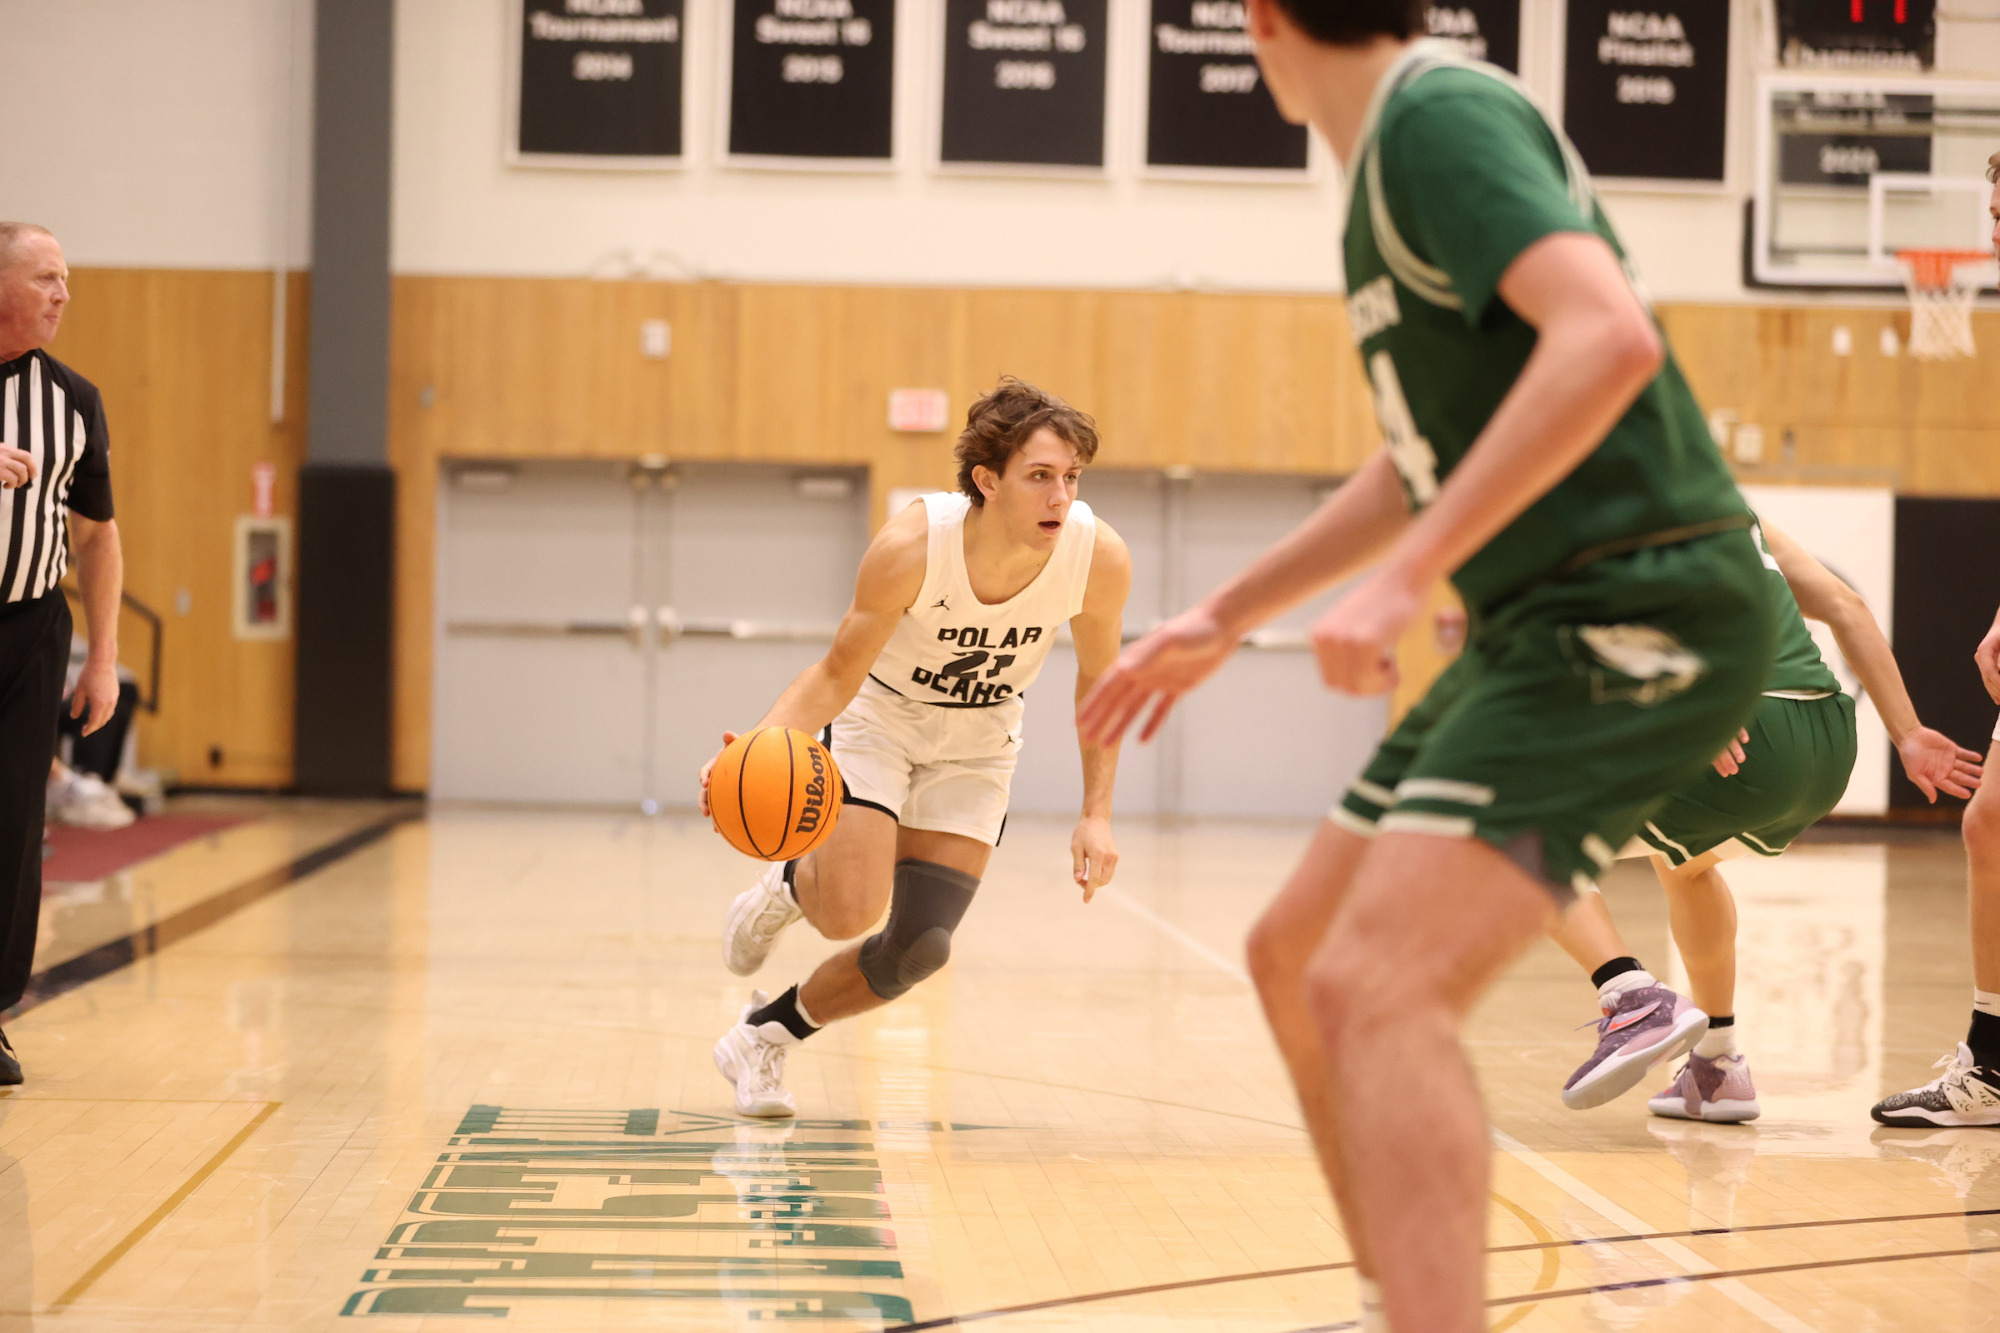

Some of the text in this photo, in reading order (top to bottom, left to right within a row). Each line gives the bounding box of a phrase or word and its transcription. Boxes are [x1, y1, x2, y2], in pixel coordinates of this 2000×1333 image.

[530, 12, 679, 42] Tournament
[1192, 2, 1247, 27] NCA
[1608, 10, 1685, 39] NCAA
[756, 15, 871, 45] Sweet 16
[968, 20, 1086, 52] Sweet 16
[1598, 36, 1695, 67] Finalist
[1200, 64, 1259, 93] 2017
[936, 626, 1043, 649] POLAR
[940, 650, 1017, 681] 21
[795, 746, 826, 834] Wilson
